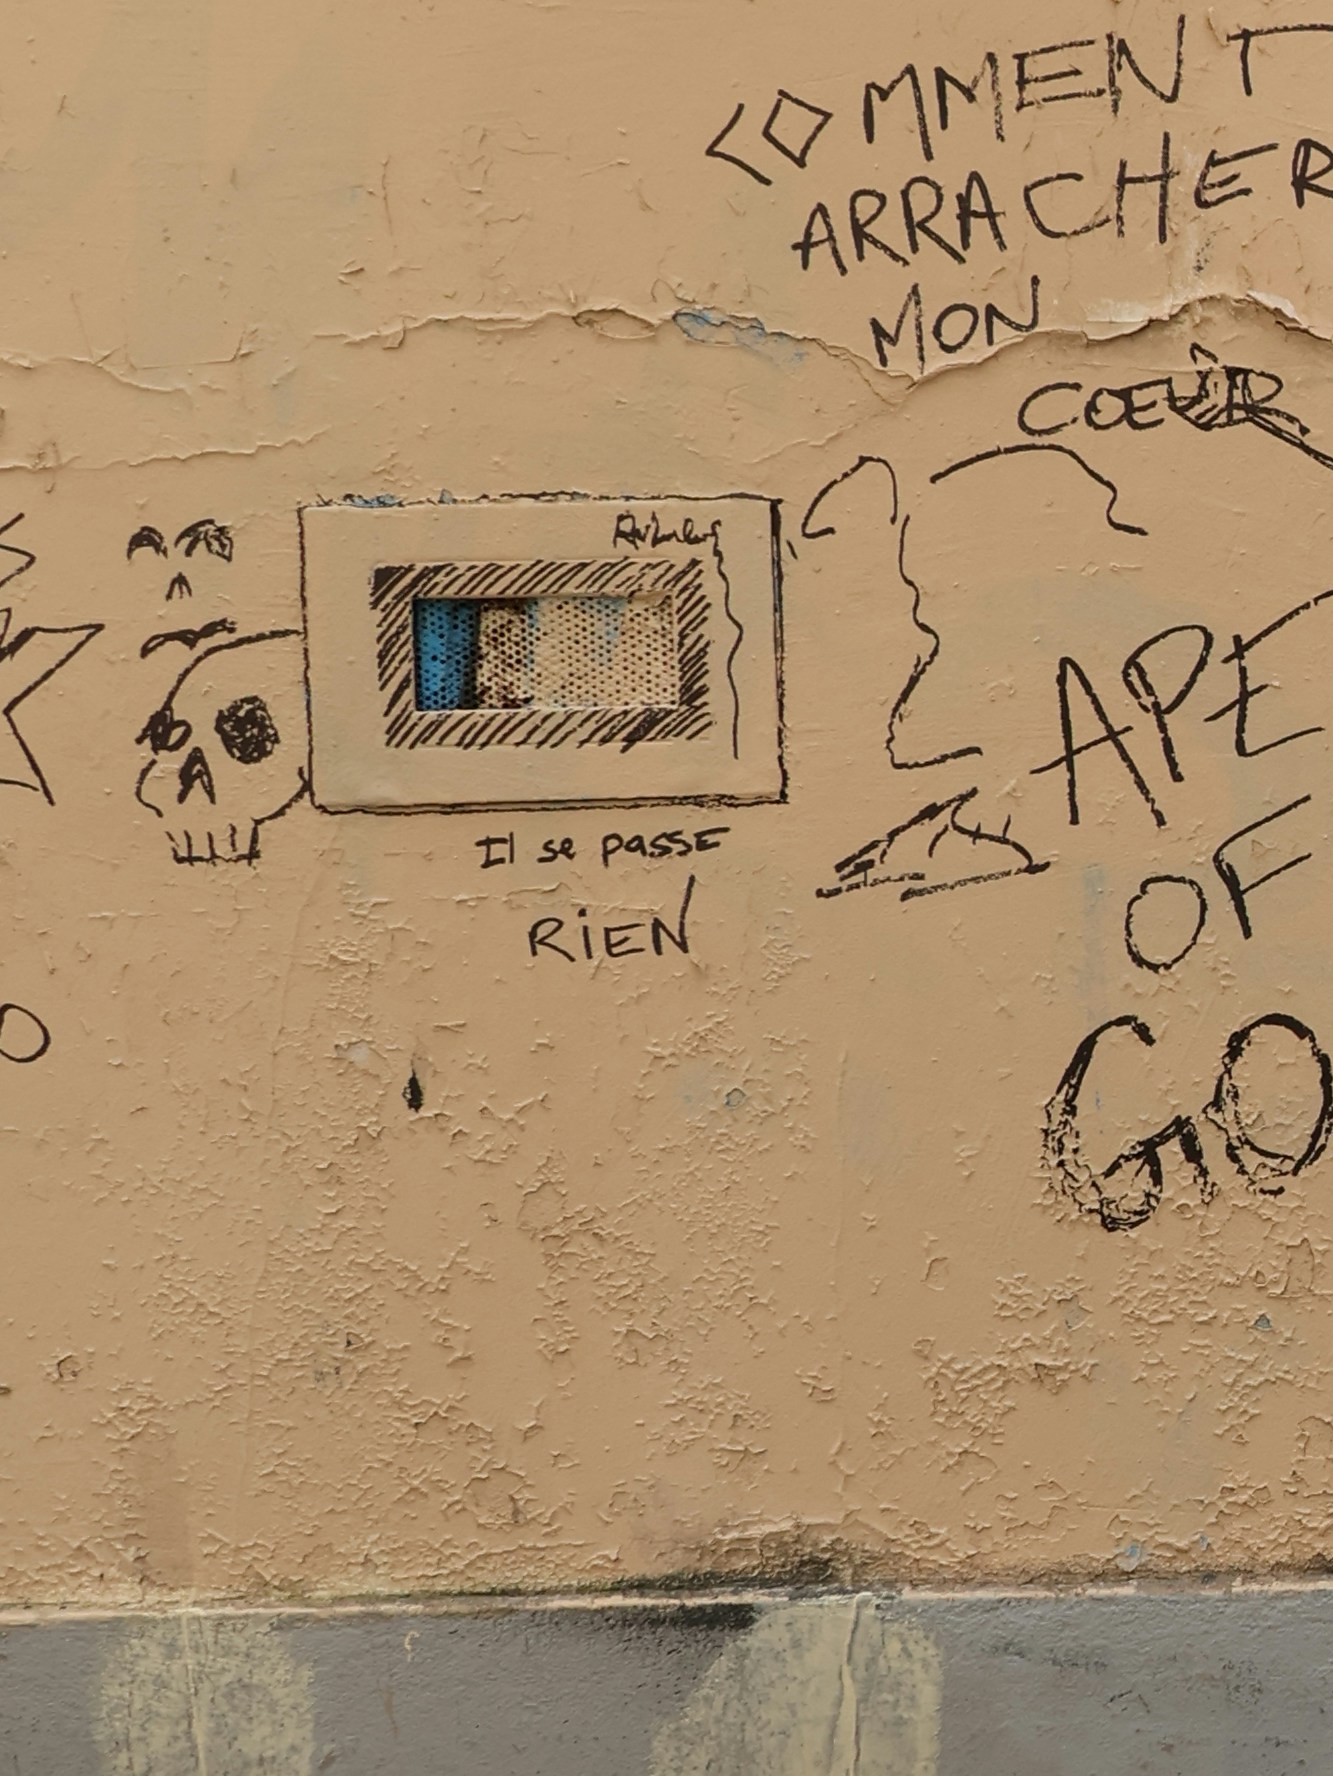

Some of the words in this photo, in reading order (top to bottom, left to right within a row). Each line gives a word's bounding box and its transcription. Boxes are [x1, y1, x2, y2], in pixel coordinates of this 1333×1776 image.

[870, 275, 1039, 373] MON
[537, 837, 577, 863] se
[1125, 794, 1313, 973] OF
